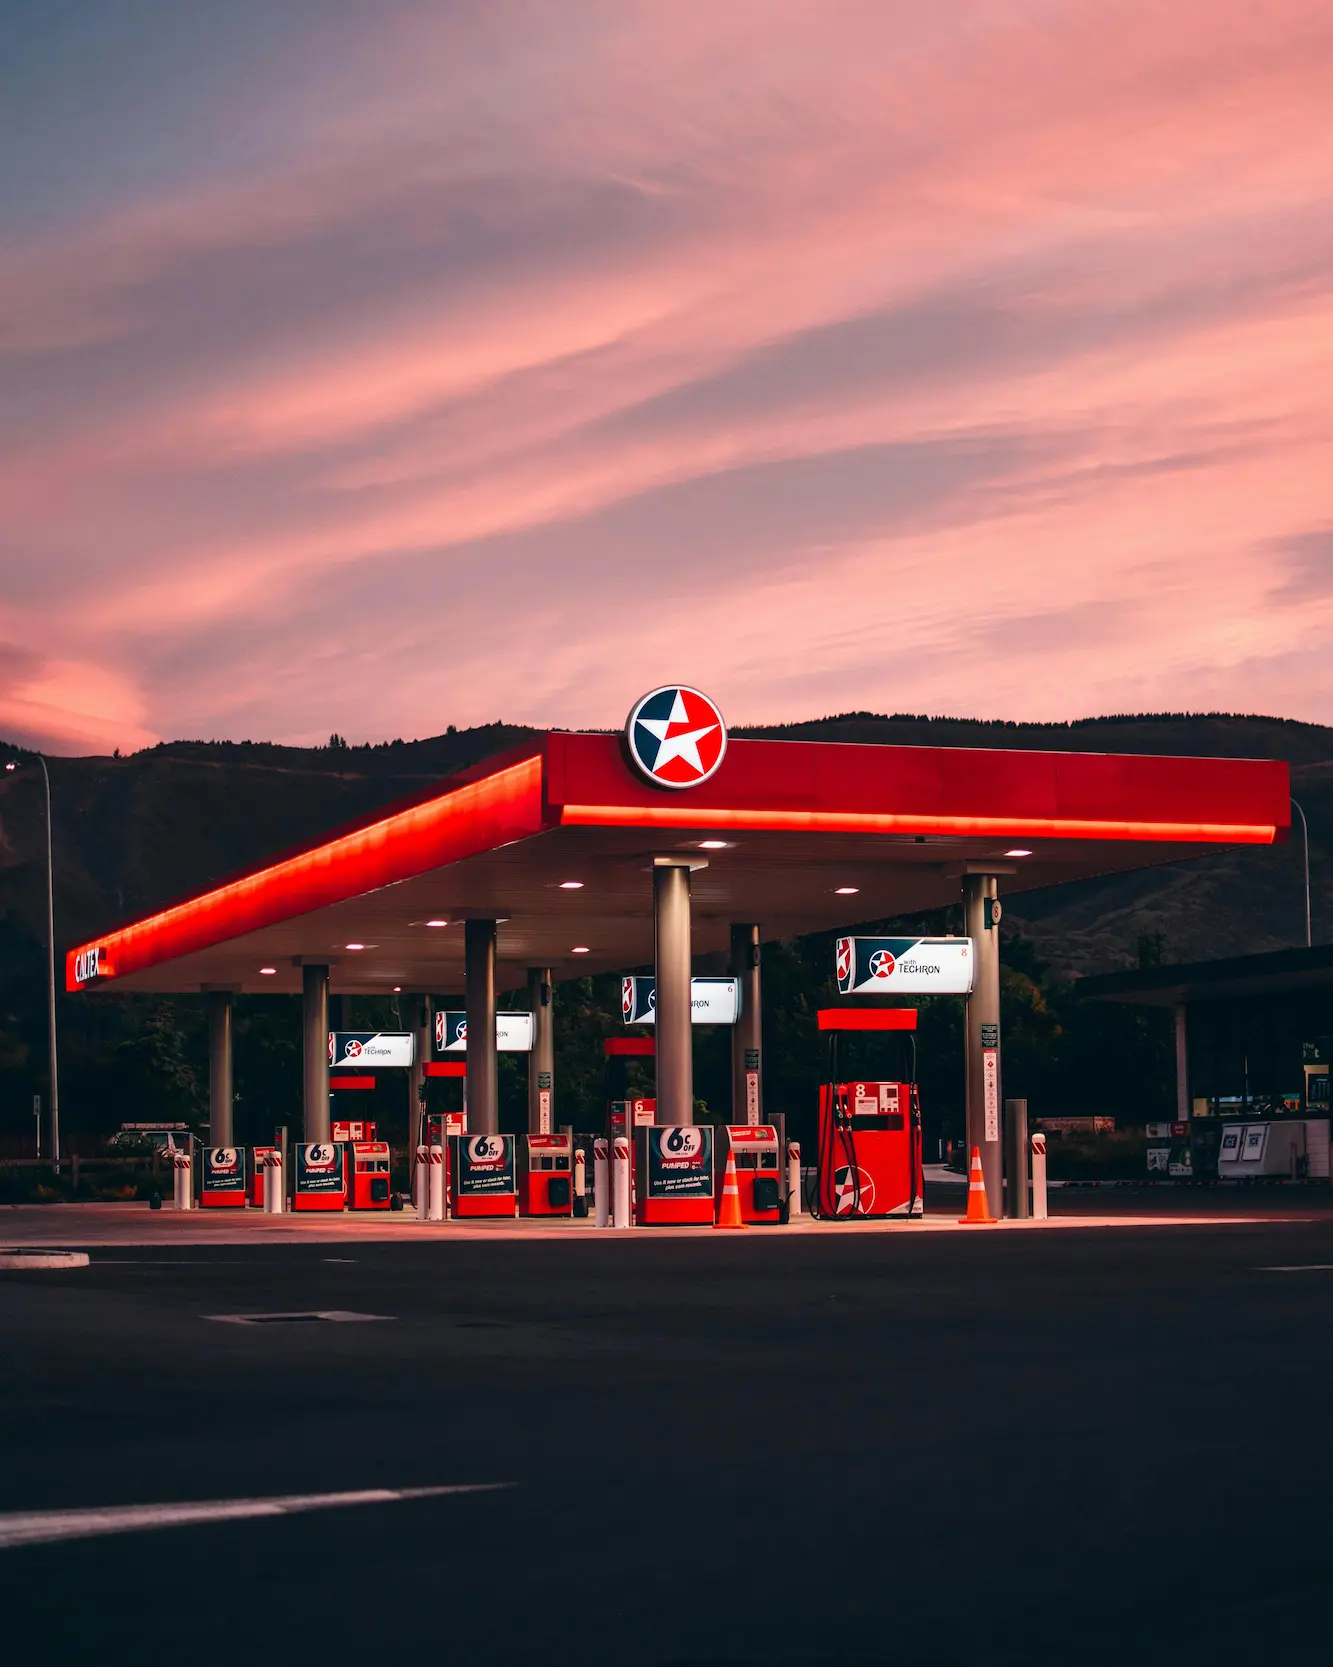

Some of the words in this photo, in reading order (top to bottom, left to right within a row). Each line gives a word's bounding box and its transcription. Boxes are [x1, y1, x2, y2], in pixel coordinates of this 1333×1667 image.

[994, 906, 999, 918] 8
[962, 948, 967, 956] 8
[75, 947, 100, 983] CALTEX
[899, 964, 940, 975] TECHRON
[856, 1084, 865, 1097] 8
[635, 1101, 643, 1112] 6
[446, 1114, 453, 1123] 4
[334, 1122, 340, 1130] 2
